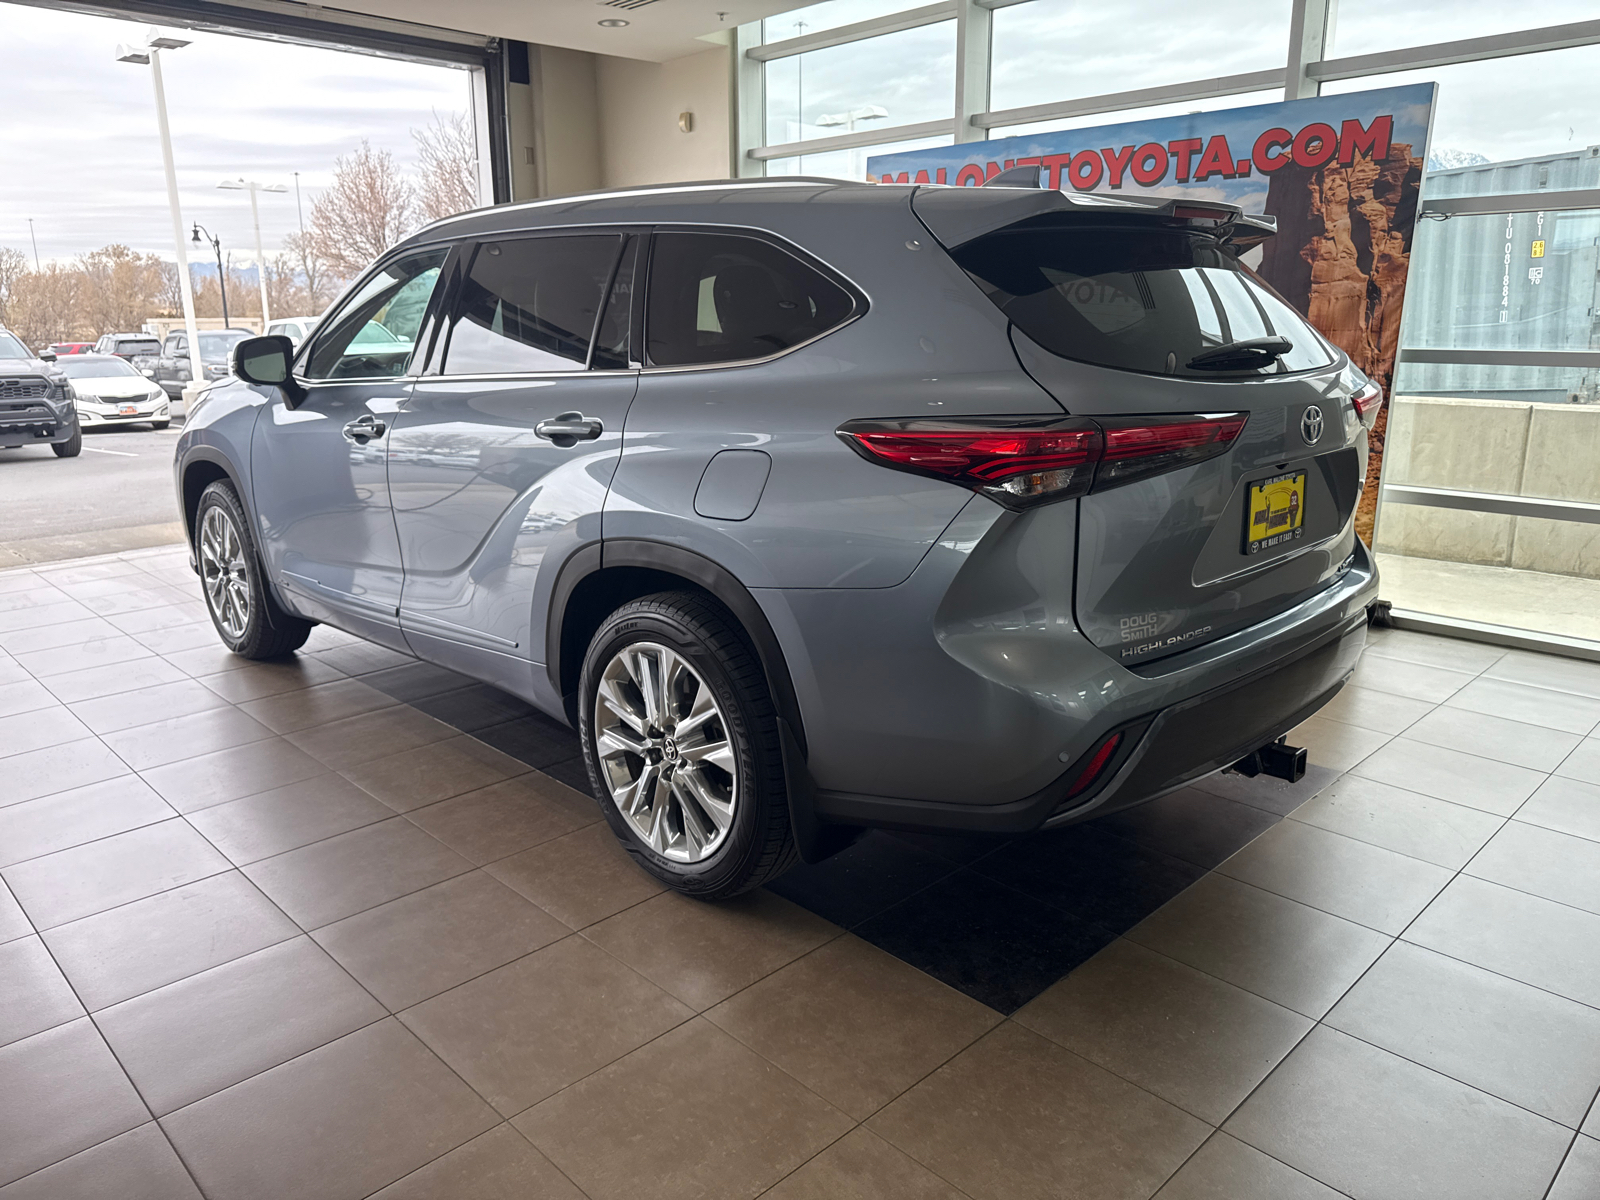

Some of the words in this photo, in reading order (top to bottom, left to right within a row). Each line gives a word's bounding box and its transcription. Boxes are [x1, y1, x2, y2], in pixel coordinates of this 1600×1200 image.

[881, 114, 1393, 191] ONTOYOTA.COM
[1501, 242, 1512, 307] 081884
[1291, 495, 1297, 505] 32
[1261, 540, 1268, 549] WE
[1268, 536, 1279, 547] MAKE
[1283, 532, 1293, 542] EASY
[1120, 612, 1157, 629] DOUG
[1119, 625, 1213, 658] HIGHLANDER
[1120, 624, 1158, 642] SMITH
